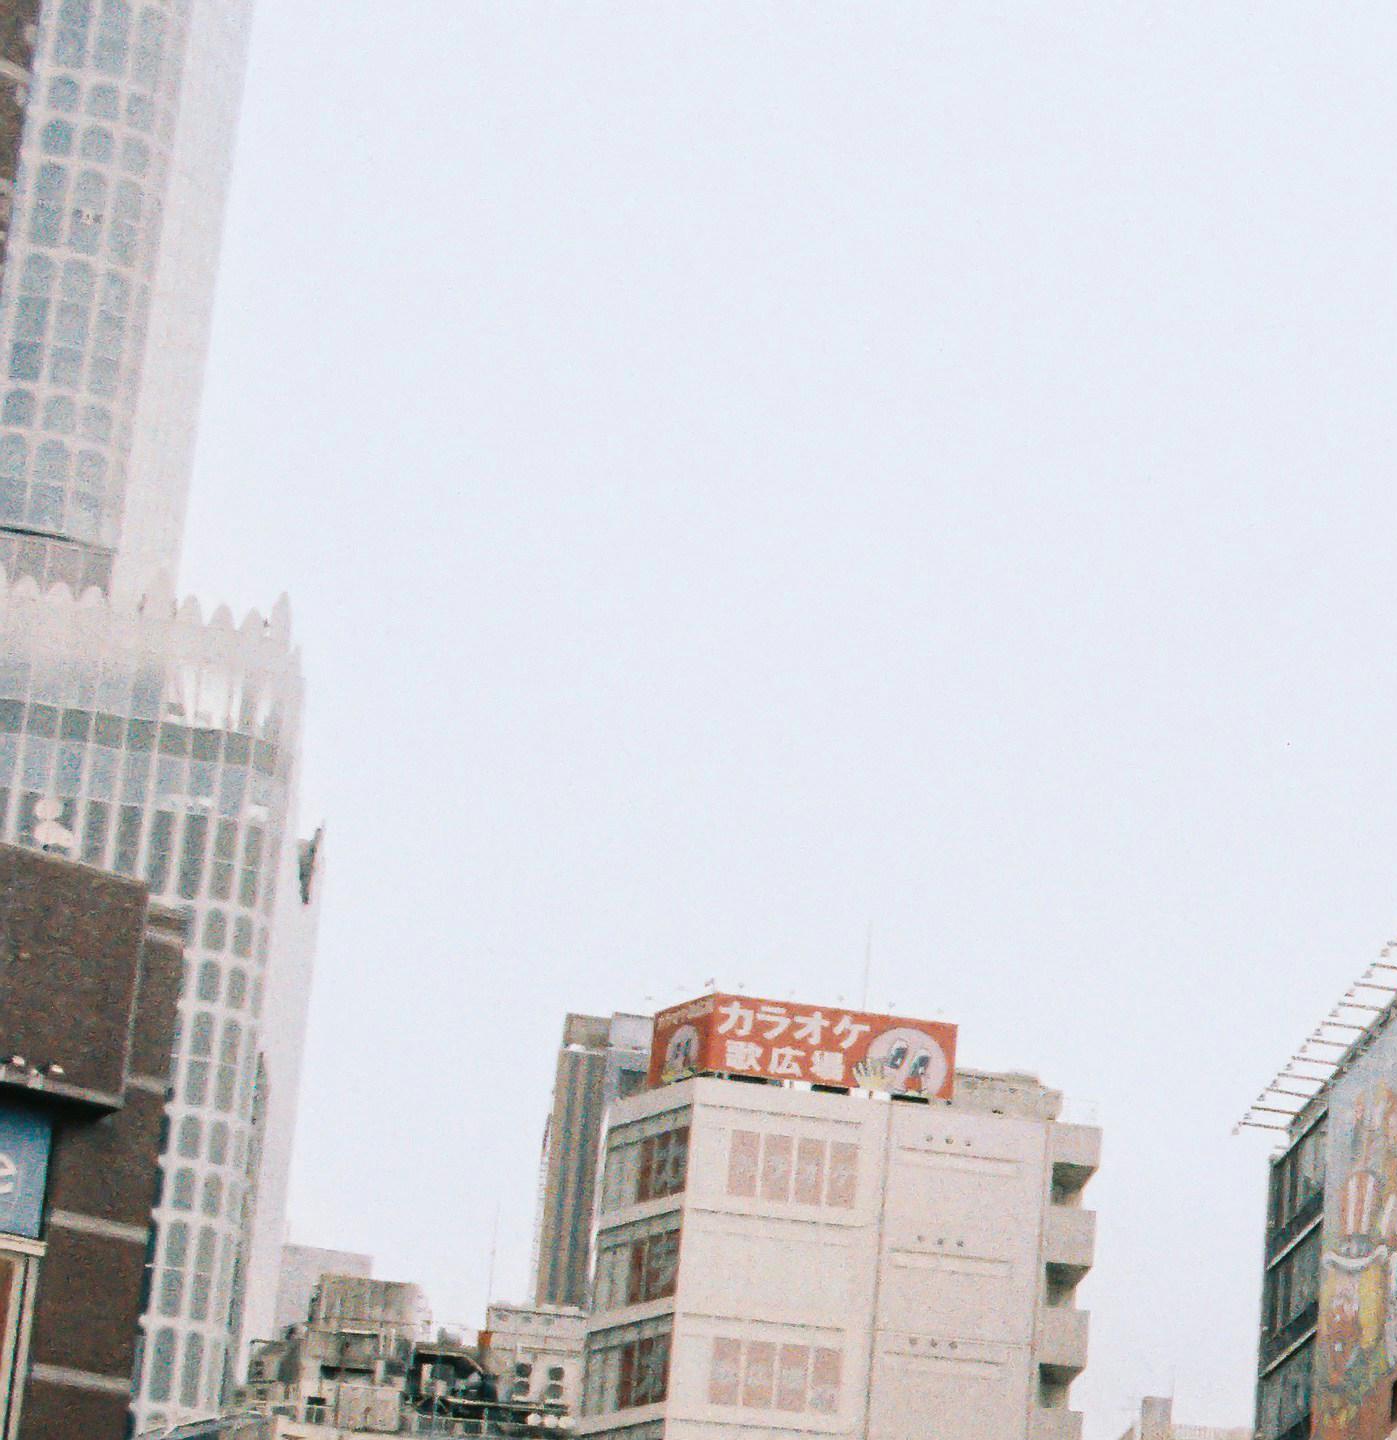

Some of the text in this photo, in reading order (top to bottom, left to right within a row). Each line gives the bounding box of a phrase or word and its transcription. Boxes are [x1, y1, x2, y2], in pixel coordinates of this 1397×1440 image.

[717, 1000, 871, 1050] カラオケ
[724, 1039, 846, 1083] 歌広場
